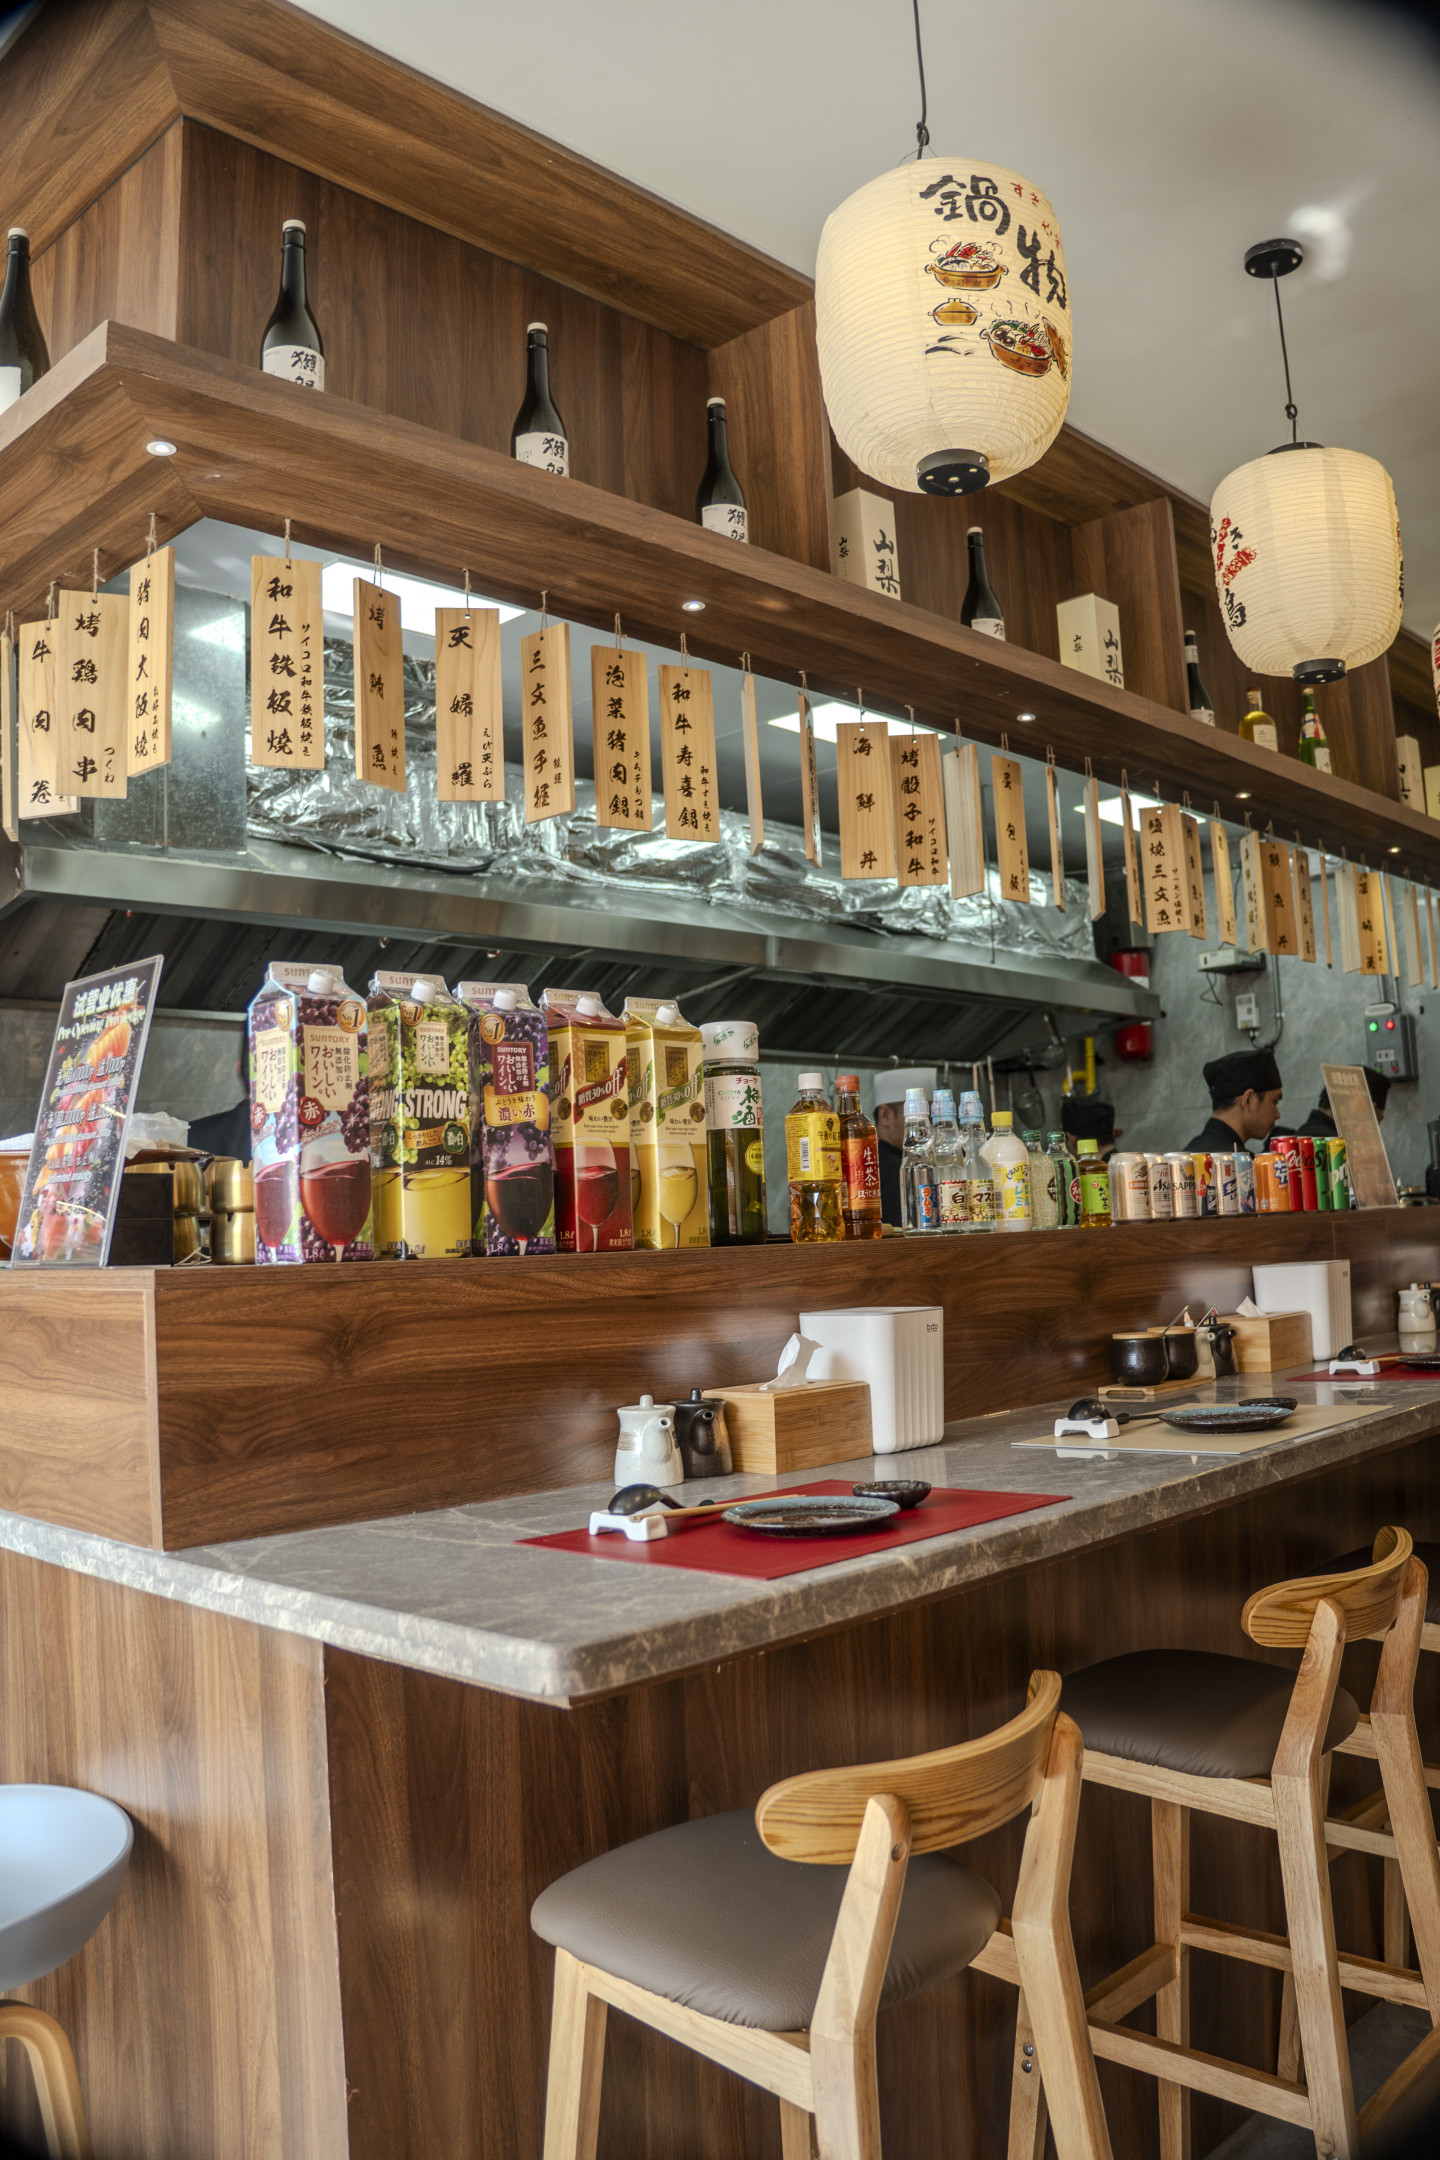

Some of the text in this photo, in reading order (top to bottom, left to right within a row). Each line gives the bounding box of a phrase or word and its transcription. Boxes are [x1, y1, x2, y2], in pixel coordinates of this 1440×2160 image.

[284, 967, 310, 976] SUNT
[390, 976, 415, 986] SUNT
[636, 1002, 658, 1010] SUNTO
[310, 1034, 350, 1044] SUNTORY
[322, 1045, 336, 1099] おいしい
[506, 1054, 517, 1094] おいしい
[736, 1077, 758, 1085] チョーヤ
[304, 1101, 320, 1121] 赤
[404, 1088, 468, 1120] STRONG
[732, 1084, 762, 1126] 梅酒
[864, 1146, 876, 1187] 生茶
[1172, 1182, 1196, 1190] SAPPO
[921, 1186, 933, 1218] ラムネ
[973, 1192, 994, 1202] マス
